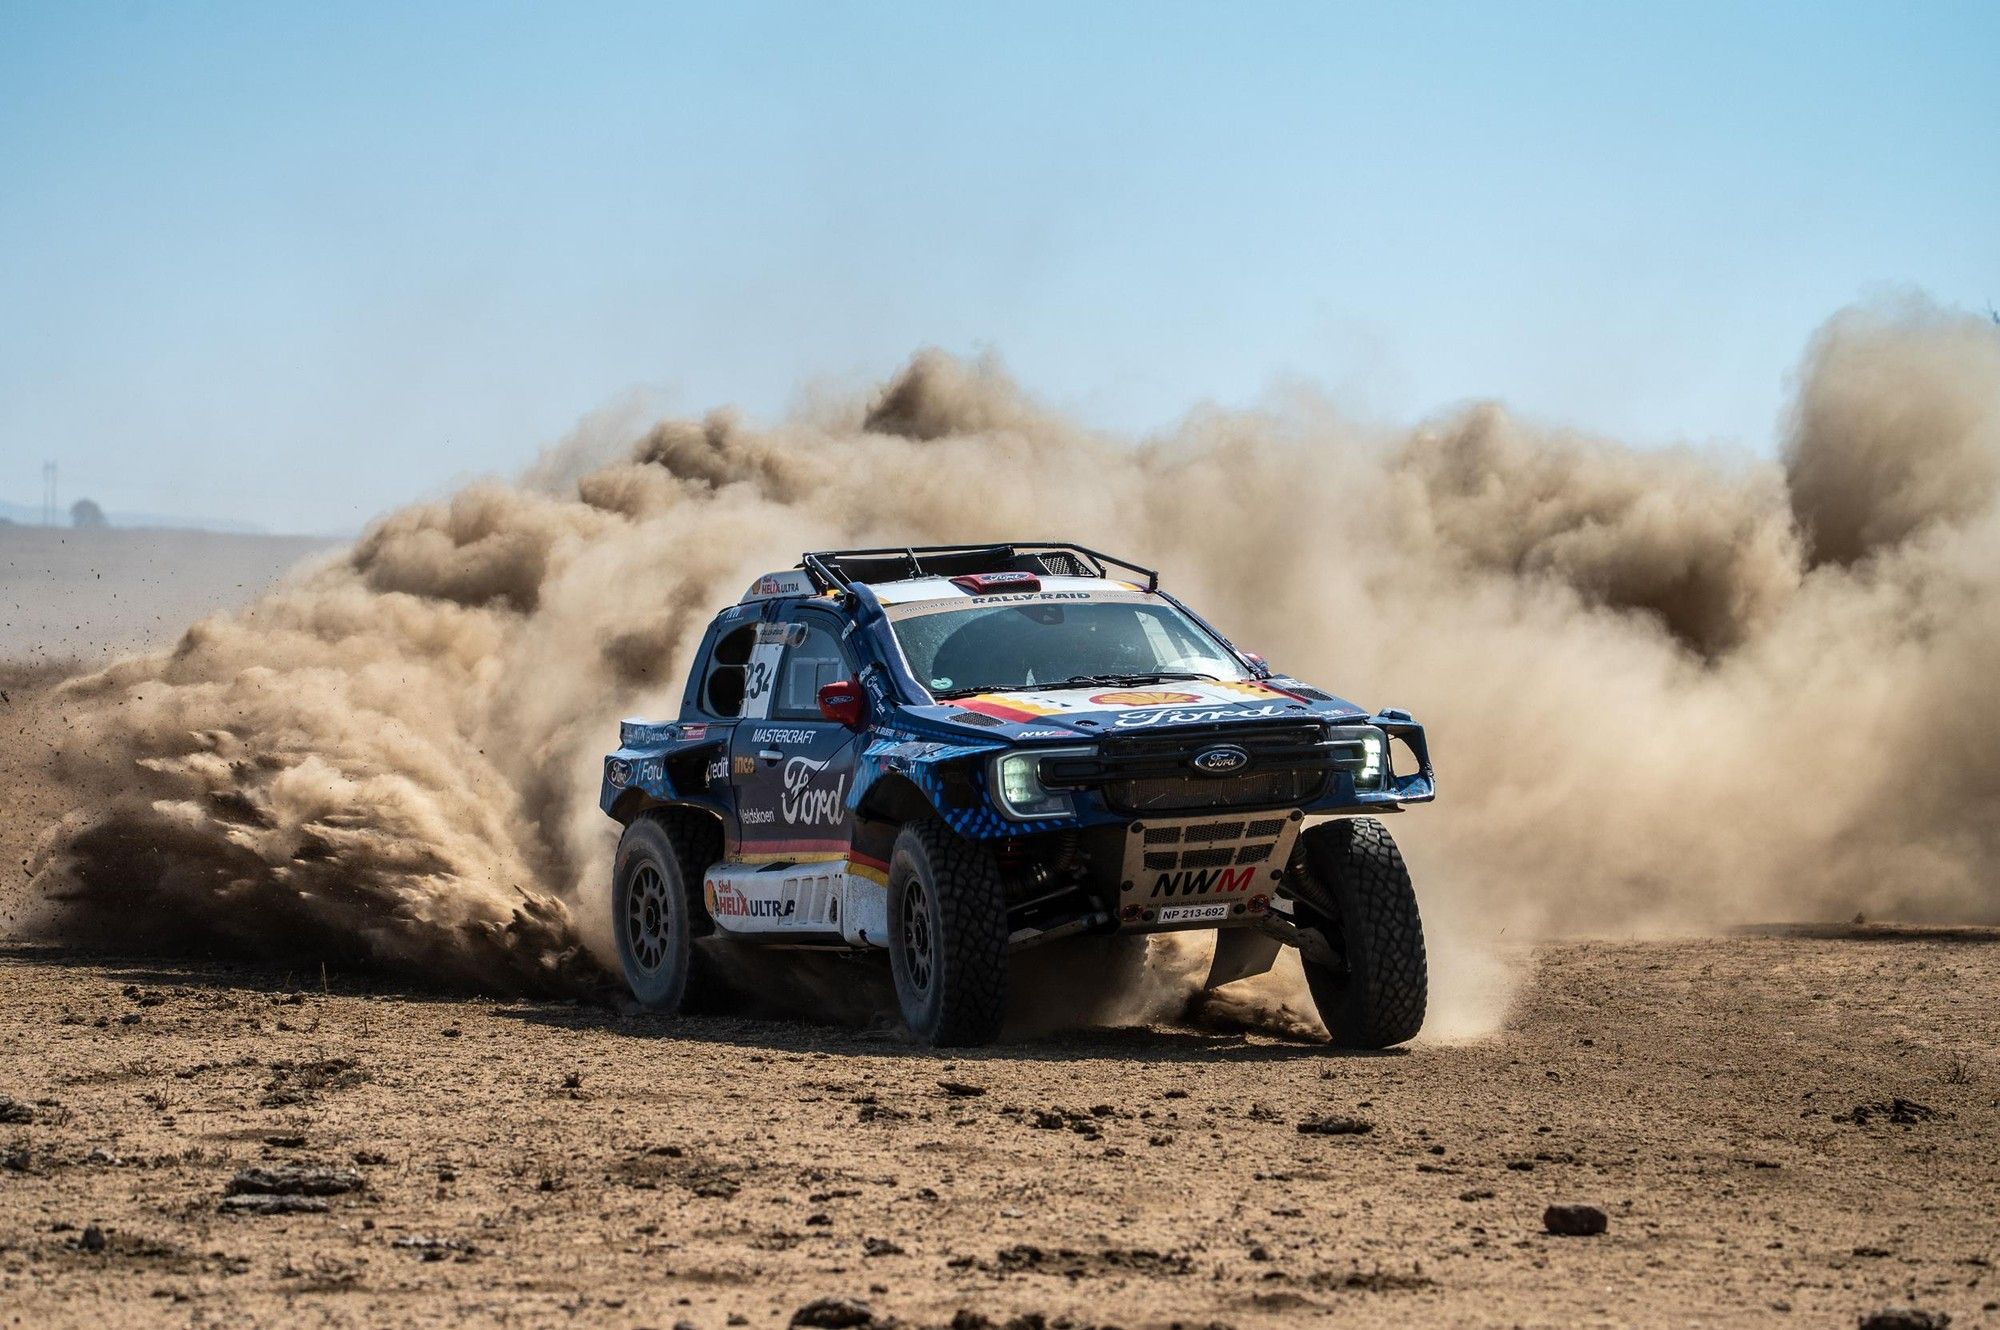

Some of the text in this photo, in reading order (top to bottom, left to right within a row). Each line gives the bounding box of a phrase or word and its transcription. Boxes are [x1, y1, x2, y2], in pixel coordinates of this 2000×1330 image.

[761, 582, 799, 594] HELIX ULTRA
[971, 592, 1091, 605] RALLY-RAID
[1114, 705, 1285, 727] Ford
[751, 728, 817, 744] MASTERCRAFT
[1208, 753, 1236, 768] Ford
[781, 756, 847, 825] Ford
[739, 807, 775, 824] Veldskoen
[718, 880, 732, 894] Shell
[1150, 866, 1257, 898] NWM
[719, 896, 796, 918] HELIX ULTRA
[1162, 907, 1225, 920] NP 213-692
